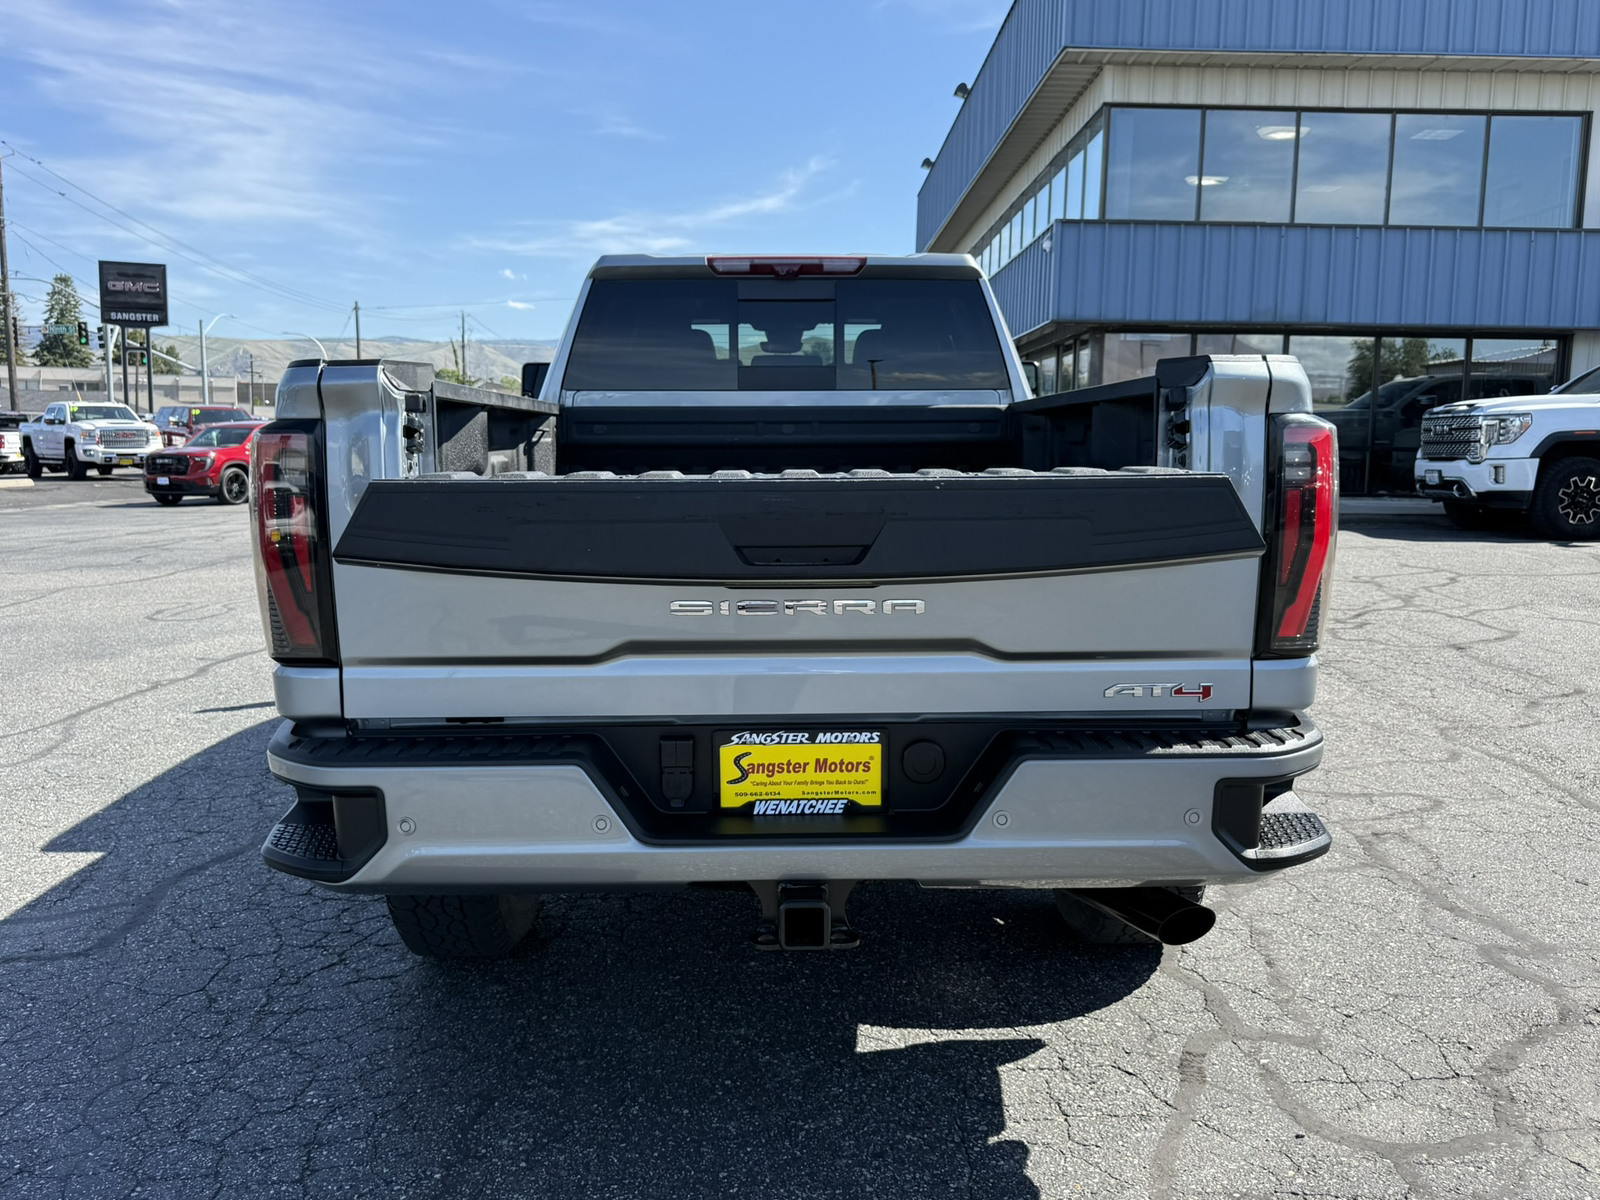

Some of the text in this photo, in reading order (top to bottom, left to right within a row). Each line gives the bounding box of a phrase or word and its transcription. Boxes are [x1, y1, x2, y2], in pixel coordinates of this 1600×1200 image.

[107, 281, 160, 292] GMC
[110, 312, 160, 322] SANGSTER
[669, 600, 926, 616] SIERRA
[1103, 683, 1213, 702] AT4
[722, 731, 881, 746] SANGSTER MOTORS
[726, 751, 810, 785] Sangster
[794, 779, 809, 787] Family
[753, 799, 849, 815] WENATCHEE
